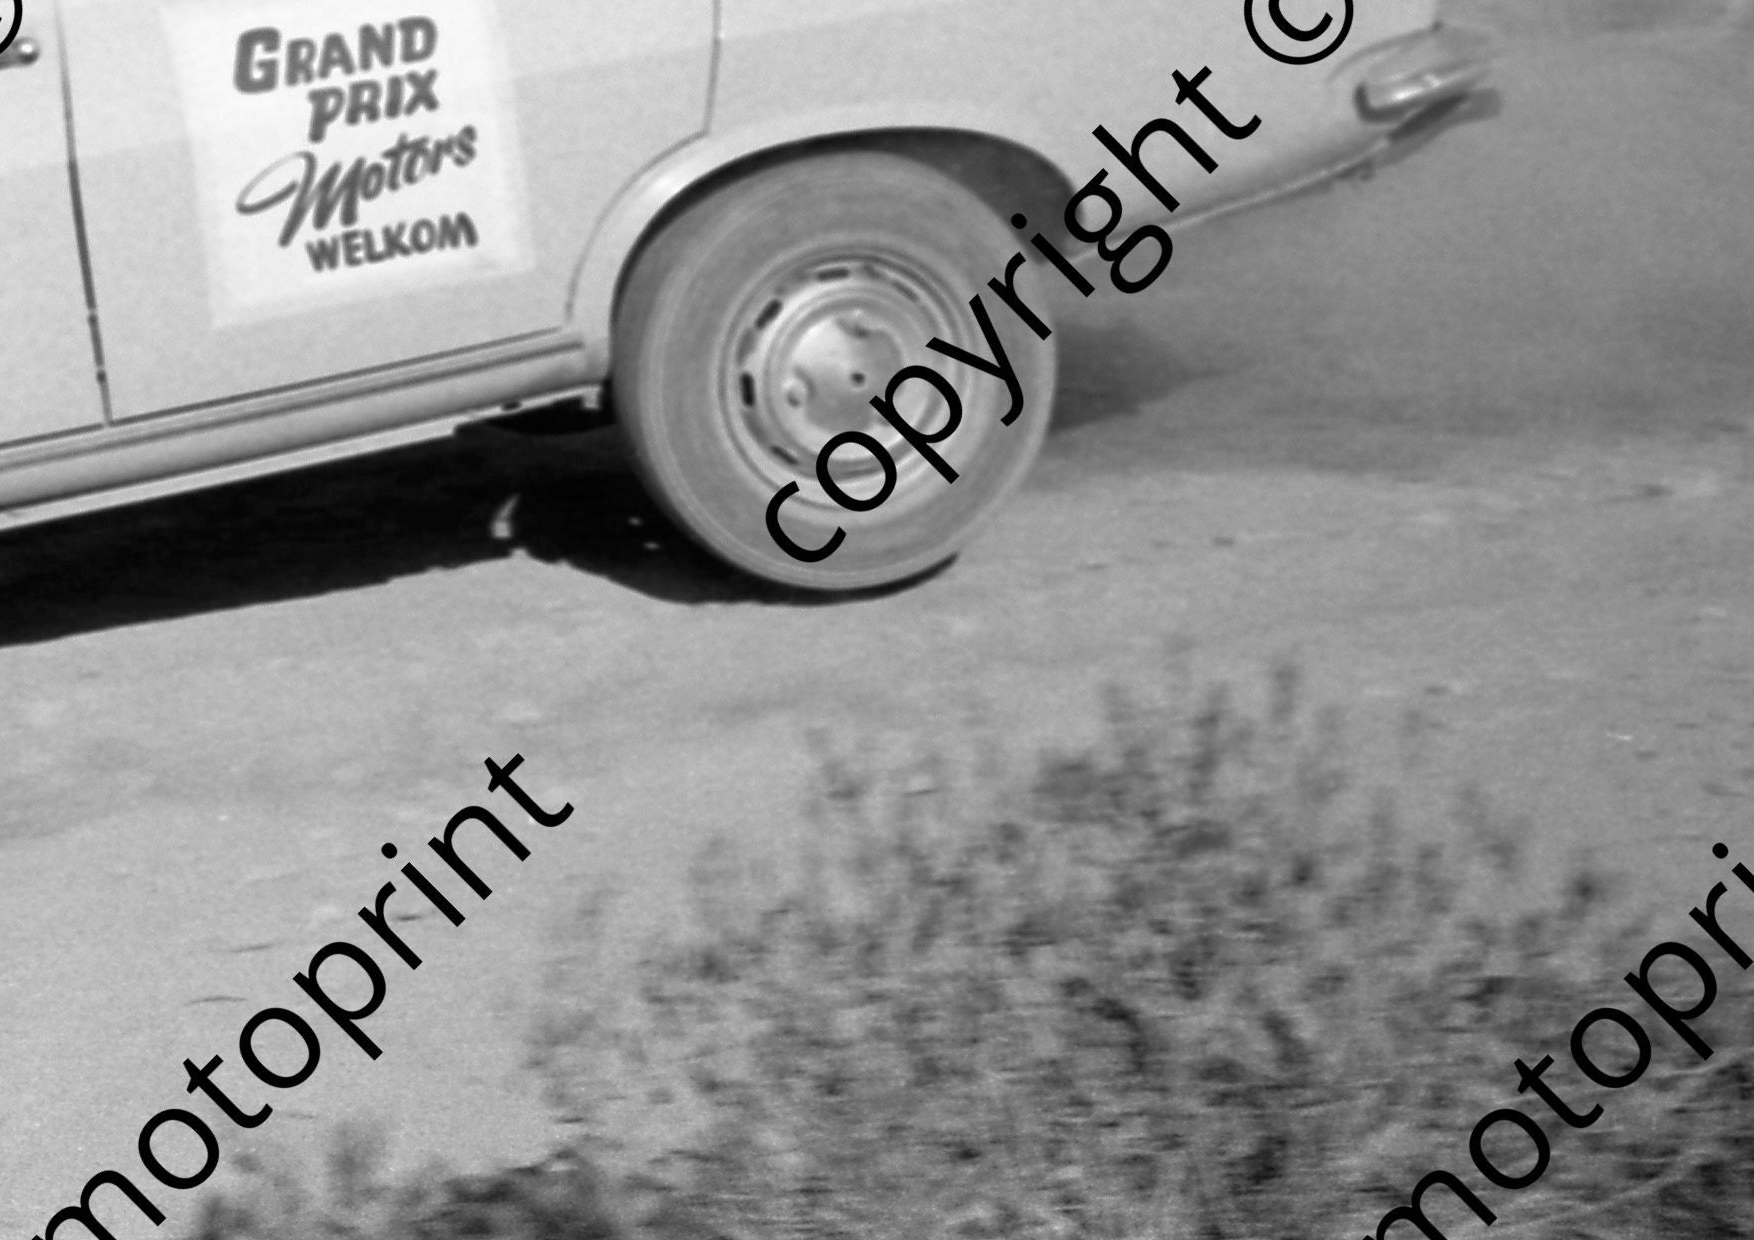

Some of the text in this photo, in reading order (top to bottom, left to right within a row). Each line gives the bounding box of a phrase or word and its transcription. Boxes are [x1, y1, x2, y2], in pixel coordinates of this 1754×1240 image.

[232, 15, 438, 94] GRAND
[307, 69, 439, 144] PRIX
[236, 124, 478, 248] Motors
[304, 211, 479, 273] WELKOM
